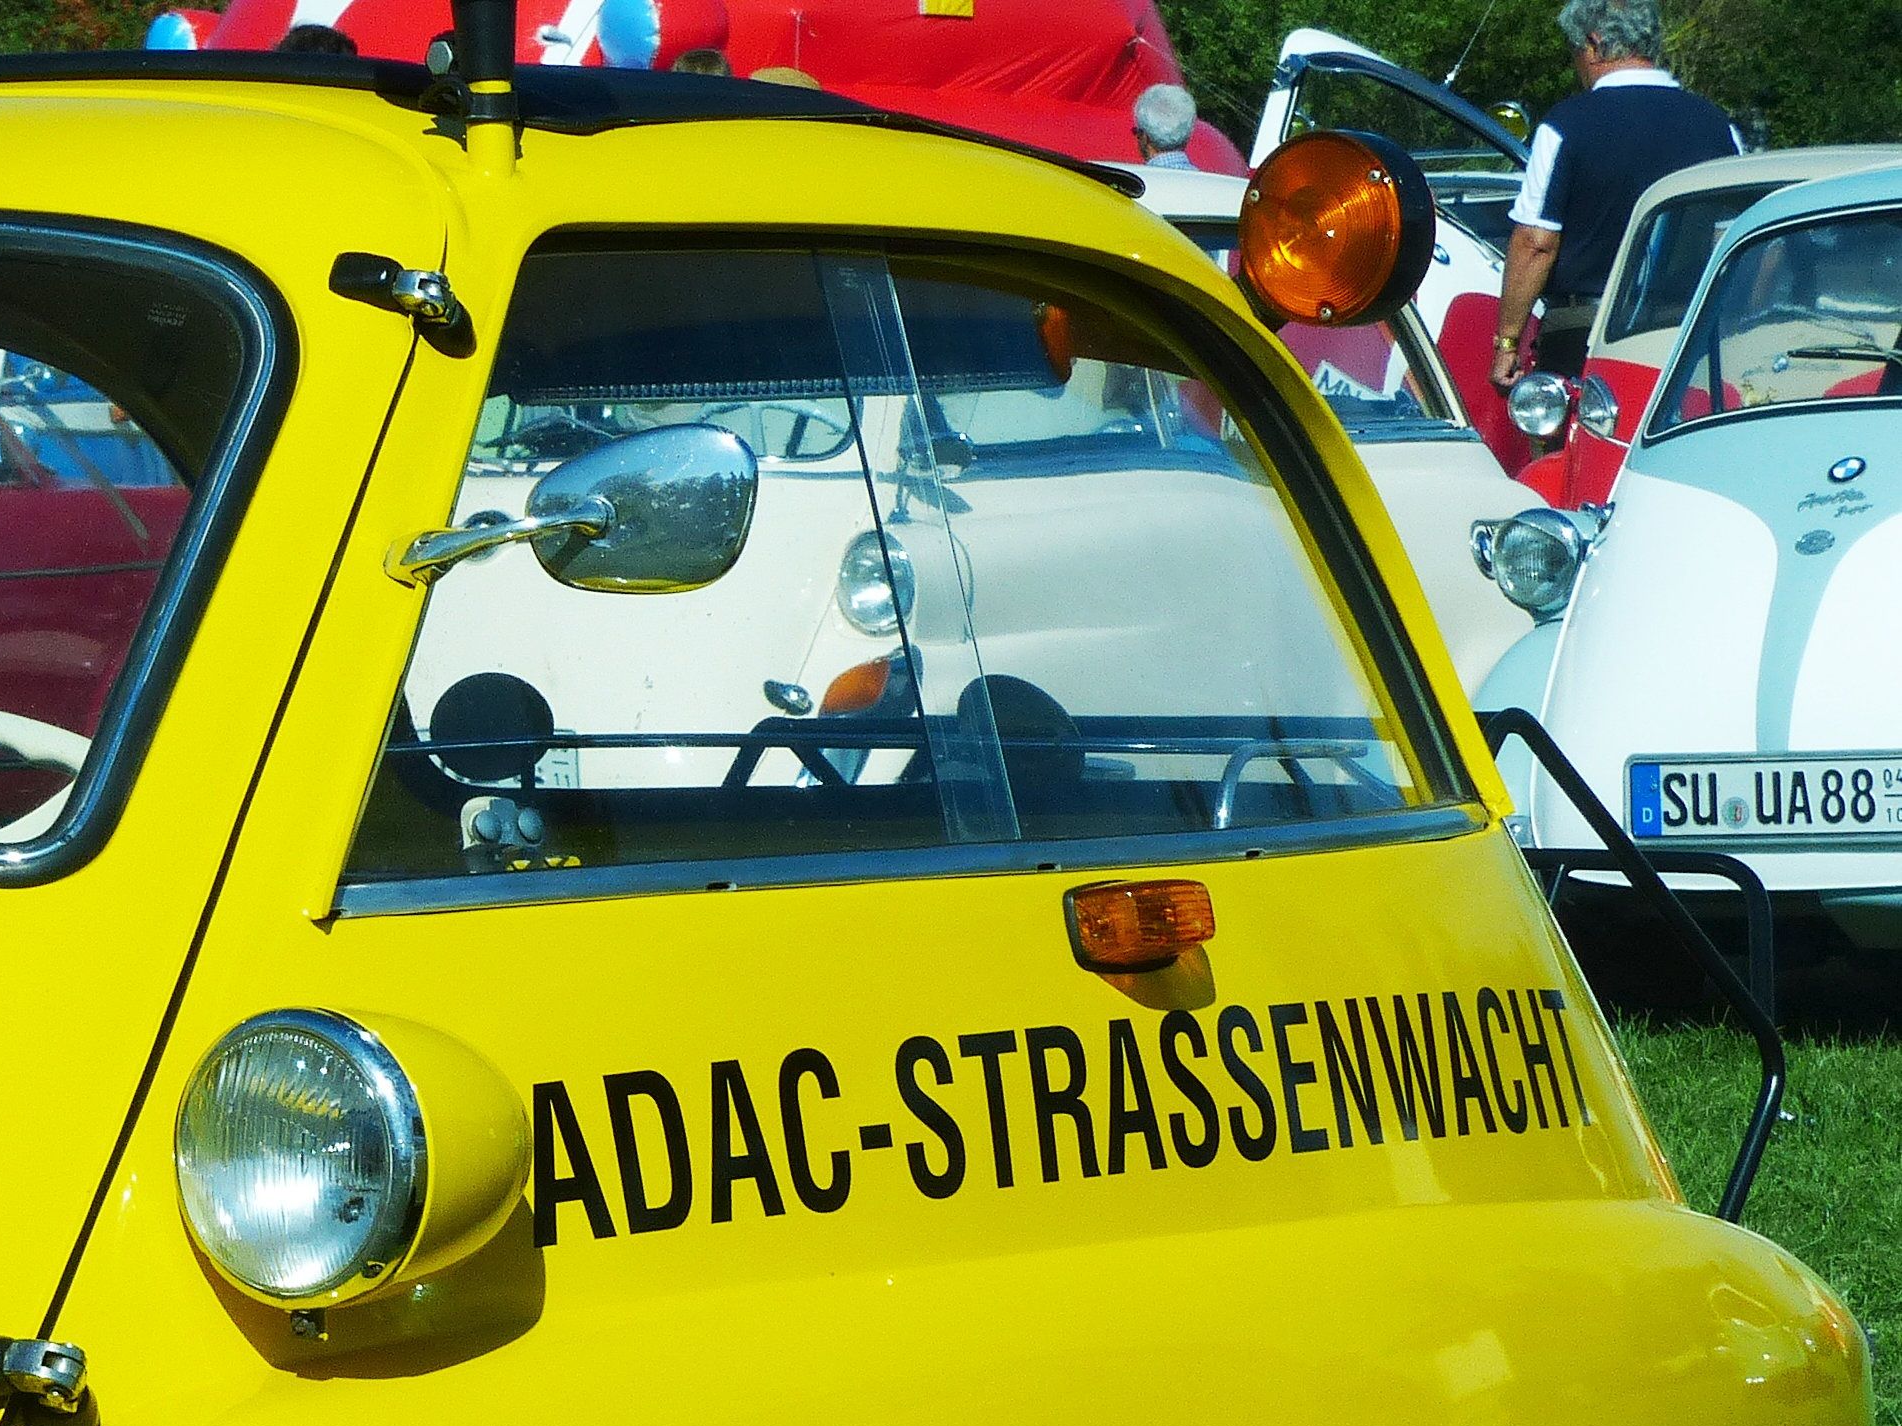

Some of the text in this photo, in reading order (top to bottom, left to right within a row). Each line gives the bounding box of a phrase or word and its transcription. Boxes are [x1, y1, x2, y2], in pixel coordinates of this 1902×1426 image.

[1642, 807, 1653, 824] D
[1662, 771, 1719, 828] SU
[533, 985, 1590, 1251] ADAC-STRASSENWACHT
